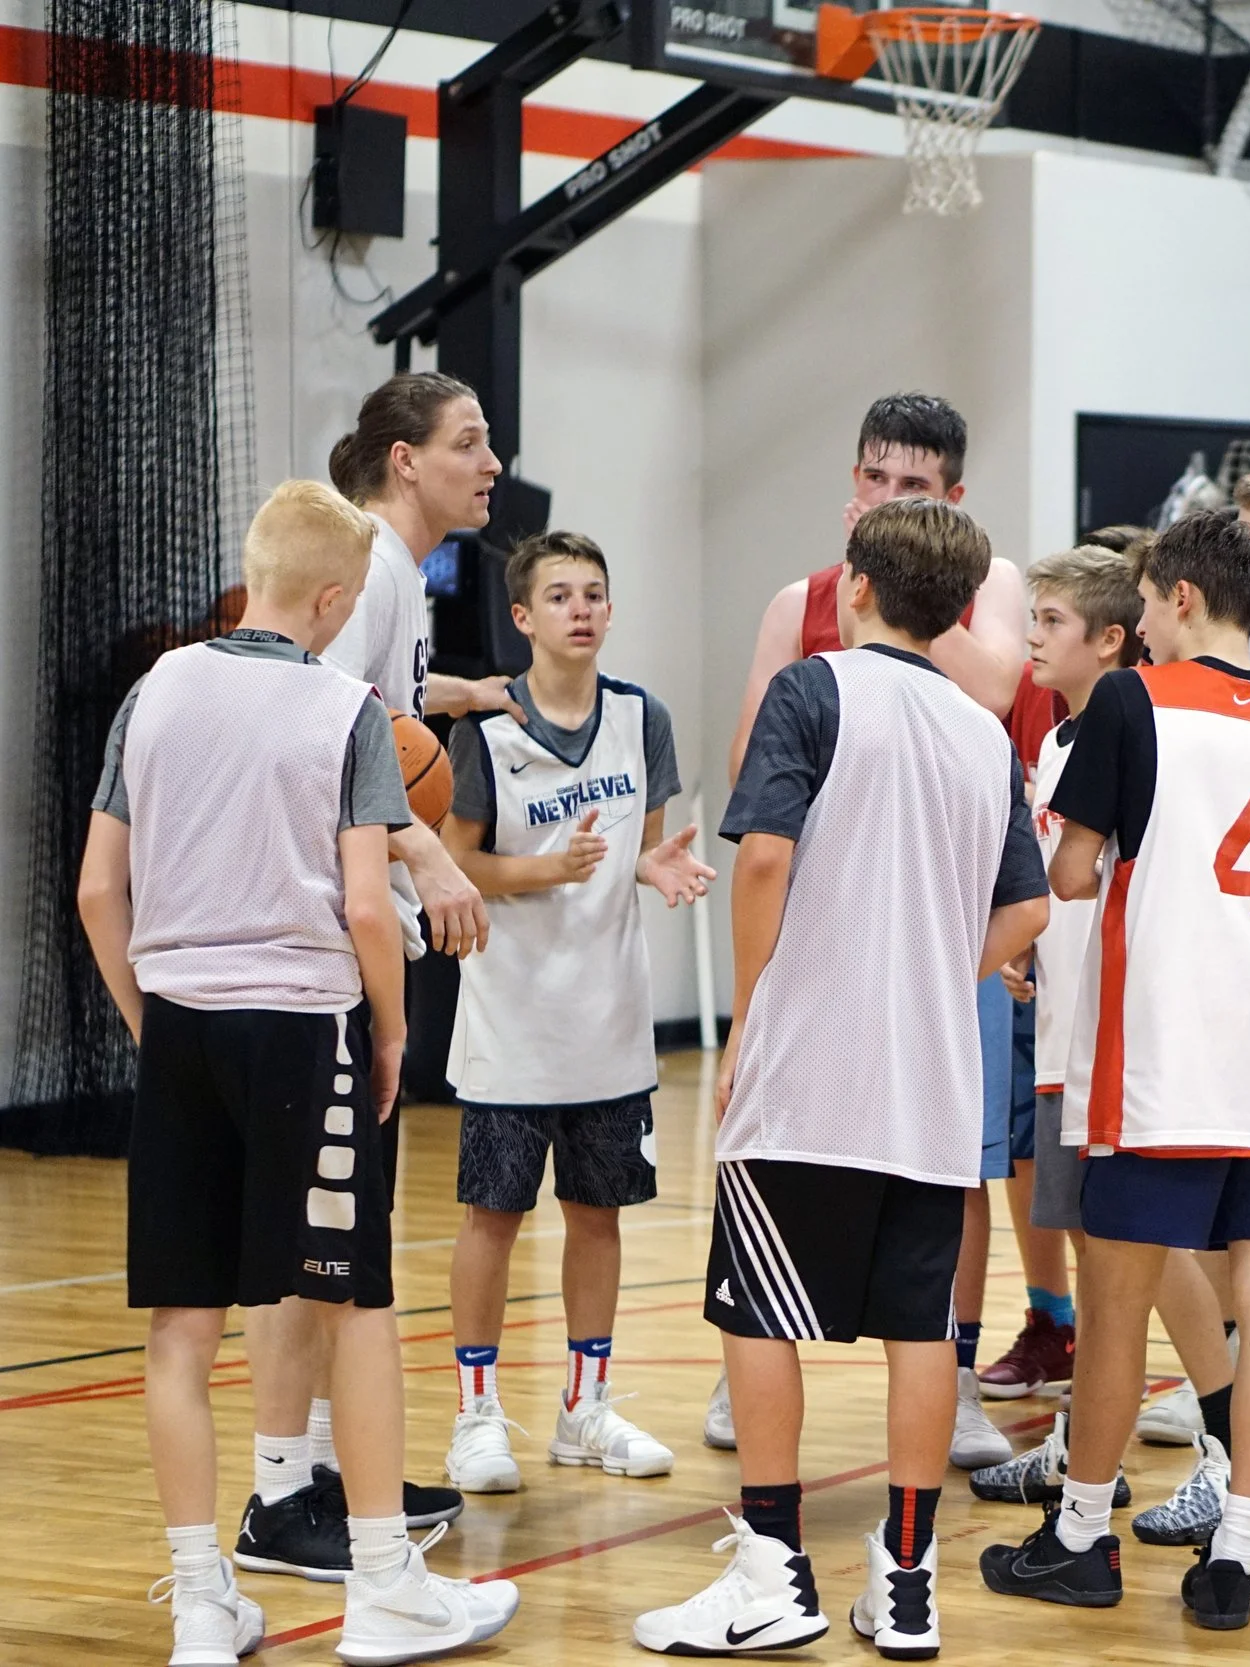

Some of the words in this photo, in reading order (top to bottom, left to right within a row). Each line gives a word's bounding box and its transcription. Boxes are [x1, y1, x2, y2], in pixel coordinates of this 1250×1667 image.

[671, 6, 705, 32] PRO
[706, 12, 747, 40] SHOT
[564, 160, 608, 200] PRO
[607, 121, 662, 171] SHOT
[230, 630, 253, 640] NIKE
[252, 630, 279, 642] PRO
[578, 773, 636, 803] LEVEL
[303, 1258, 351, 1276] ELITE
